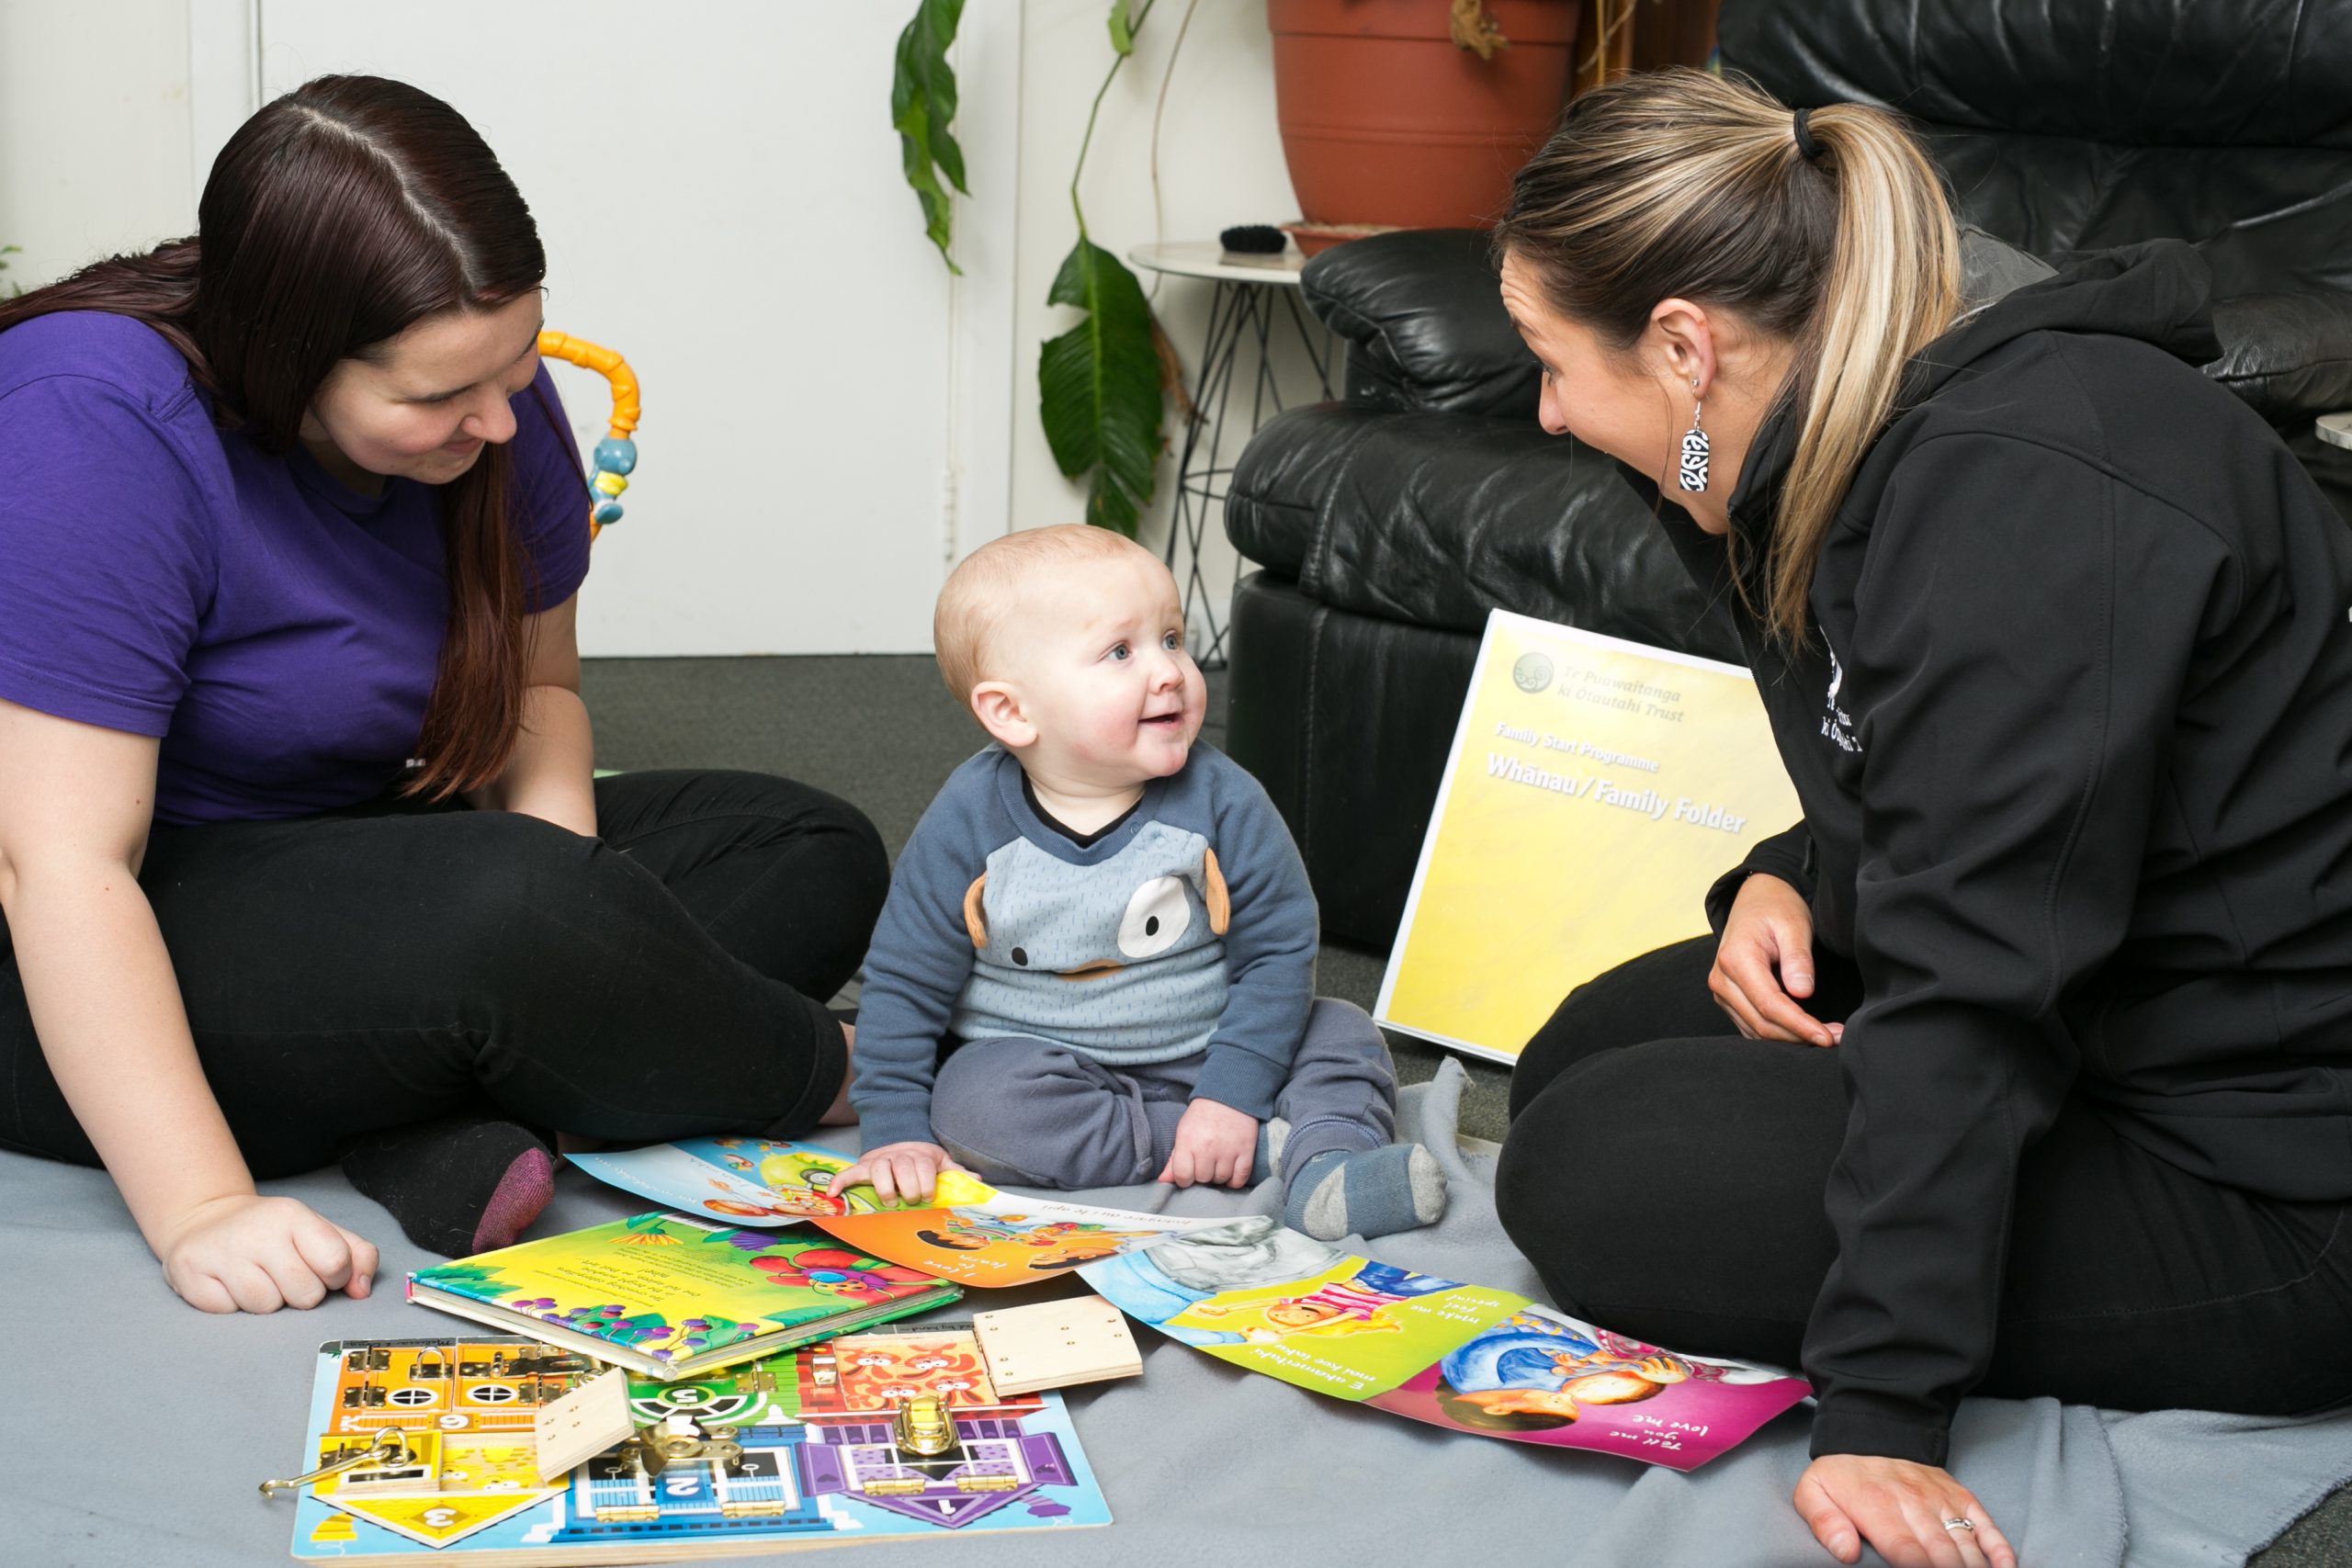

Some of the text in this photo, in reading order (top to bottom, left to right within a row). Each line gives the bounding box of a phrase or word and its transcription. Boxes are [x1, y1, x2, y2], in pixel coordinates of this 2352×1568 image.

[1563, 666, 1682, 705] Te Puawaitanga
[1557, 682, 1574, 698] ki
[1644, 704, 1685, 724] Trust
[1495, 721, 1660, 774] Family Start Programme
[1674, 797, 1747, 836] Folder
[922, 1259, 960, 1274] love
[958, 1253, 1008, 1271] learn
[1442, 1303, 1478, 1314] feel
[1443, 1293, 1500, 1308] special
[1410, 1305, 1432, 1314] me
[1348, 1382, 1365, 1391] E
[672, 1387, 699, 1404] 5
[439, 1414, 469, 1429] 6
[1632, 1415, 1709, 1438] love me
[1609, 1430, 1682, 1450] Tell me
[1643, 1428, 1679, 1440] you
[665, 1476, 699, 1496] 2
[937, 1499, 956, 1515] 1
[424, 1507, 458, 1528] 3
